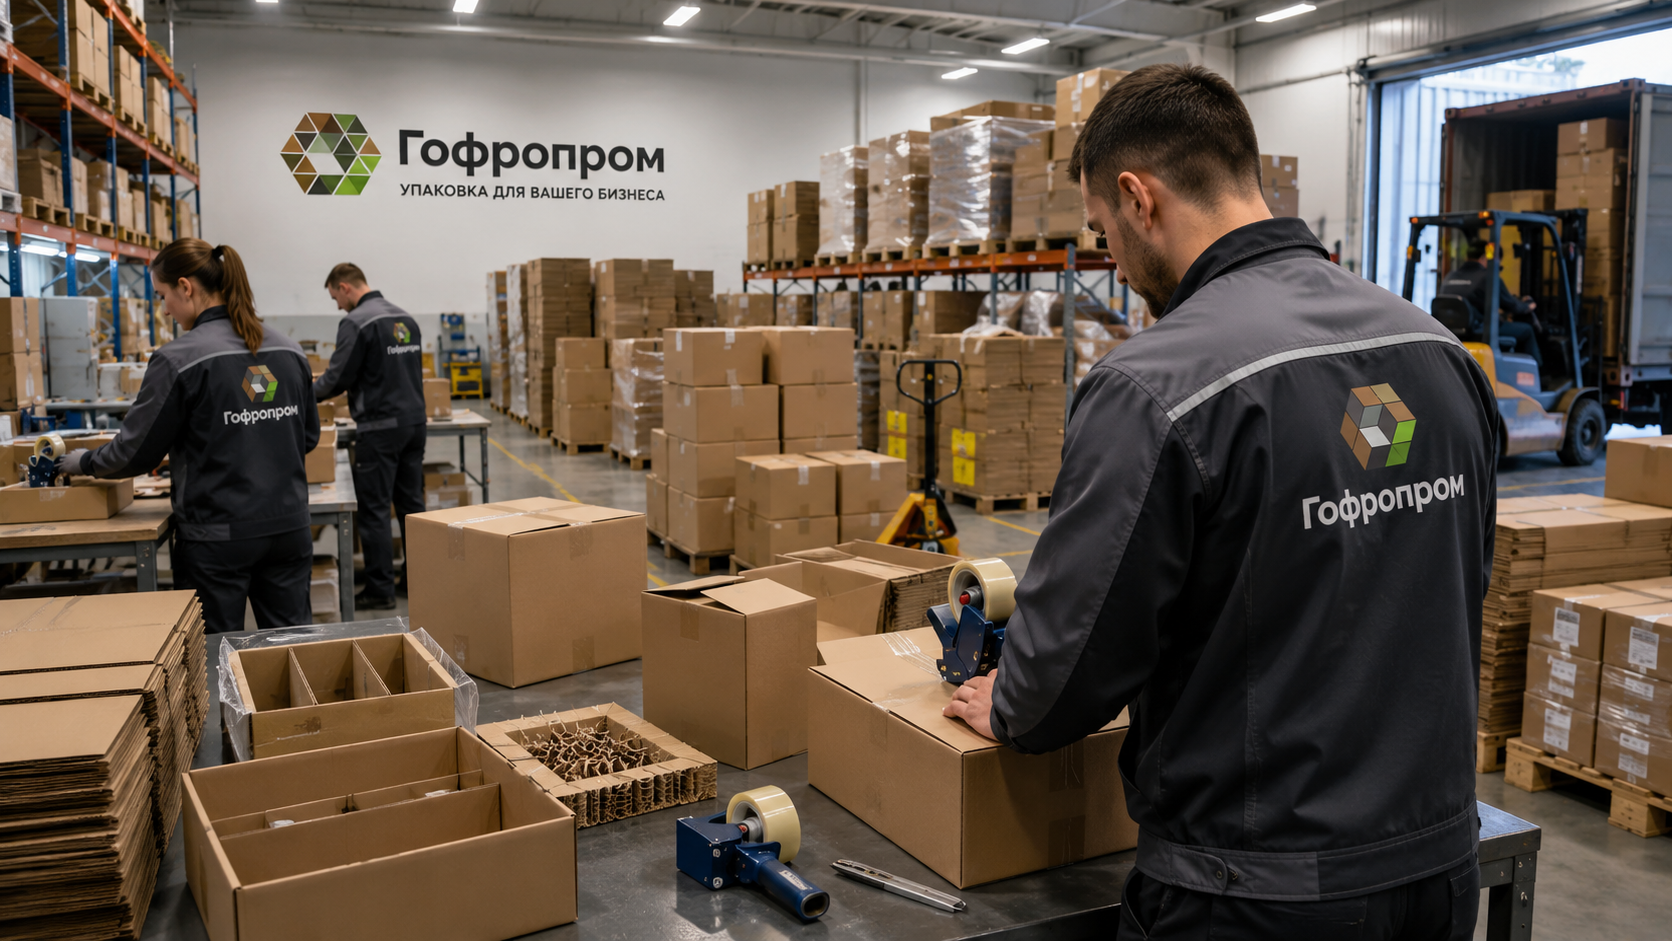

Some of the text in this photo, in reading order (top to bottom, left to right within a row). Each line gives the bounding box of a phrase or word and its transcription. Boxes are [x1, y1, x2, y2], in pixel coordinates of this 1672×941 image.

[399, 129, 665, 180] Гофропром
[400, 184, 665, 201] УПАКОВКА ДЛЯ ВАШЕГО БИЗНЕСА
[223, 405, 298, 426] Гофропром
[1302, 474, 1465, 530] Гофропром
